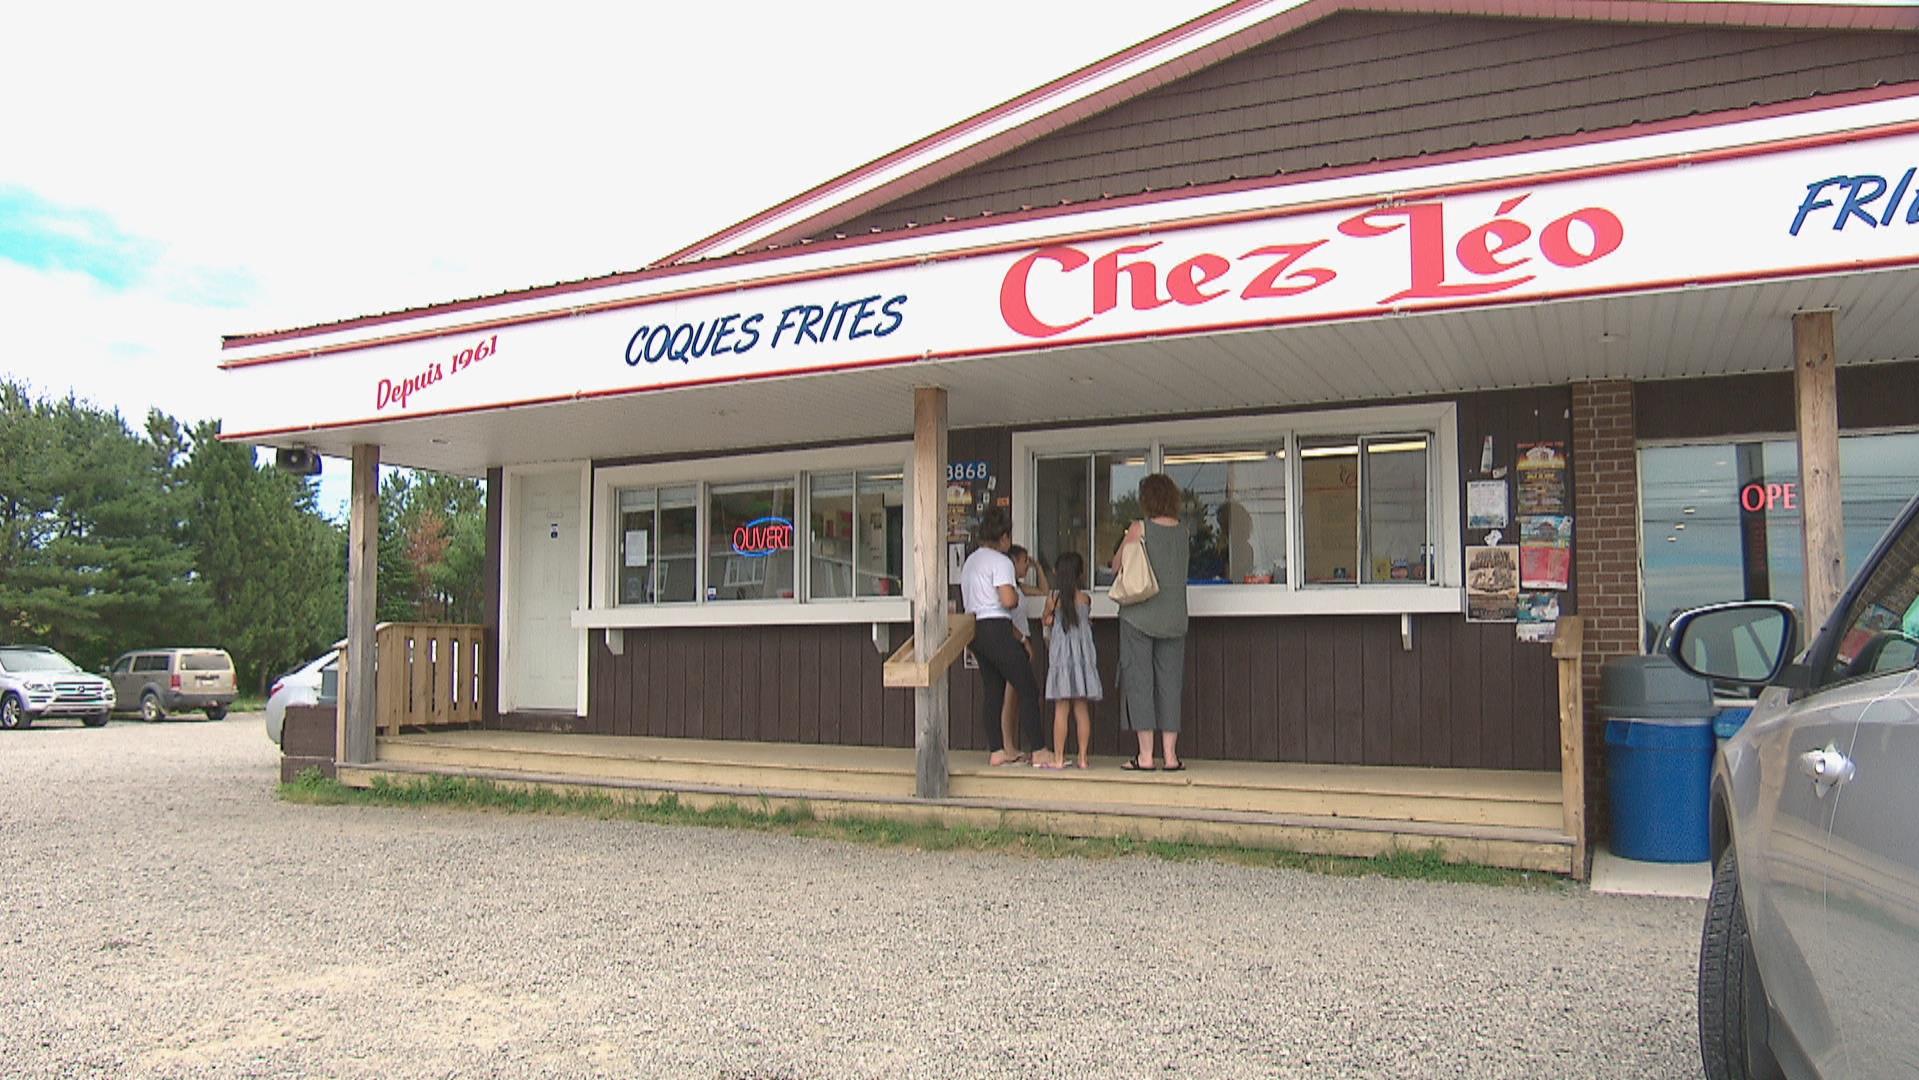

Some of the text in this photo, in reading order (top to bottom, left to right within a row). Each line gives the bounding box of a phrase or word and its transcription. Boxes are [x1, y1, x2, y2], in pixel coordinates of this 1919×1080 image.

[1000, 193, 1624, 338] Chez Léo
[625, 294, 908, 367] COQUES FRITES
[377, 335, 498, 409] Depuis 1961
[1741, 483, 1797, 512] OPE
[733, 526, 789, 550] OUVERT
